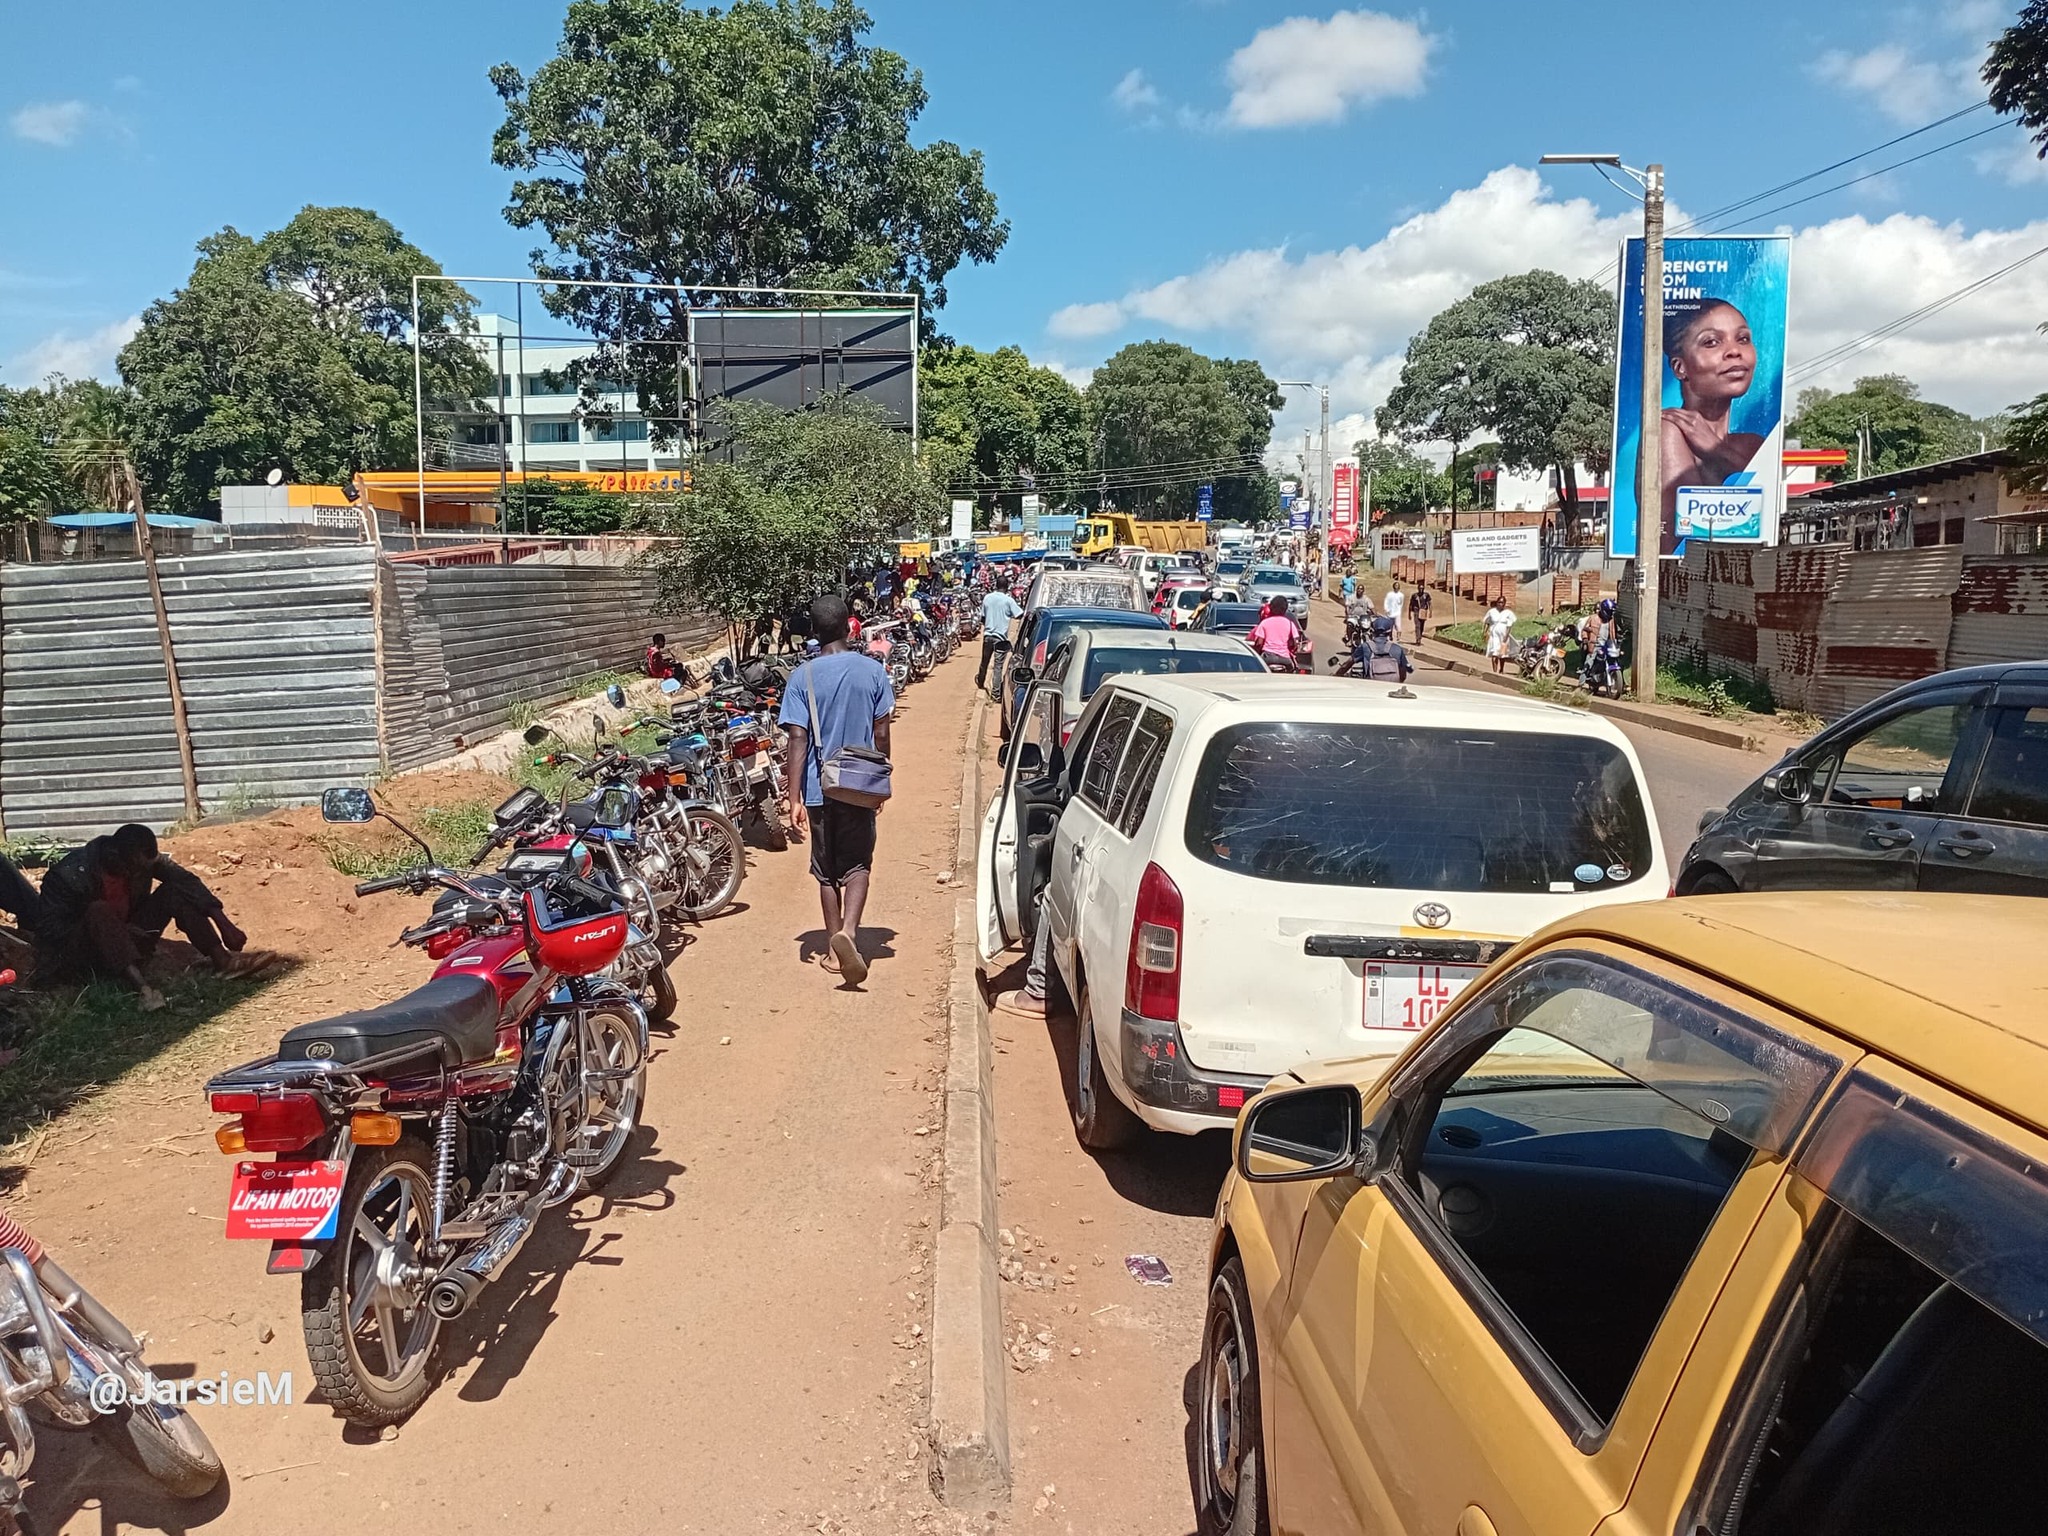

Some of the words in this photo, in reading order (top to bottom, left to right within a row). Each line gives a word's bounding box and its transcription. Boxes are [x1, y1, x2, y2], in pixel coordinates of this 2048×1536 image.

[1642, 260, 1728, 272] RENGTH
[1640, 273, 1687, 287] OM
[1640, 287, 1702, 300] THIN
[1688, 499, 1750, 517] Protex
[574, 925, 616, 943] LIFAN
[1418, 966, 1448, 996] LL
[231, 1190, 280, 1211] LIFAN
[278, 1187, 338, 1209] MOTOR
